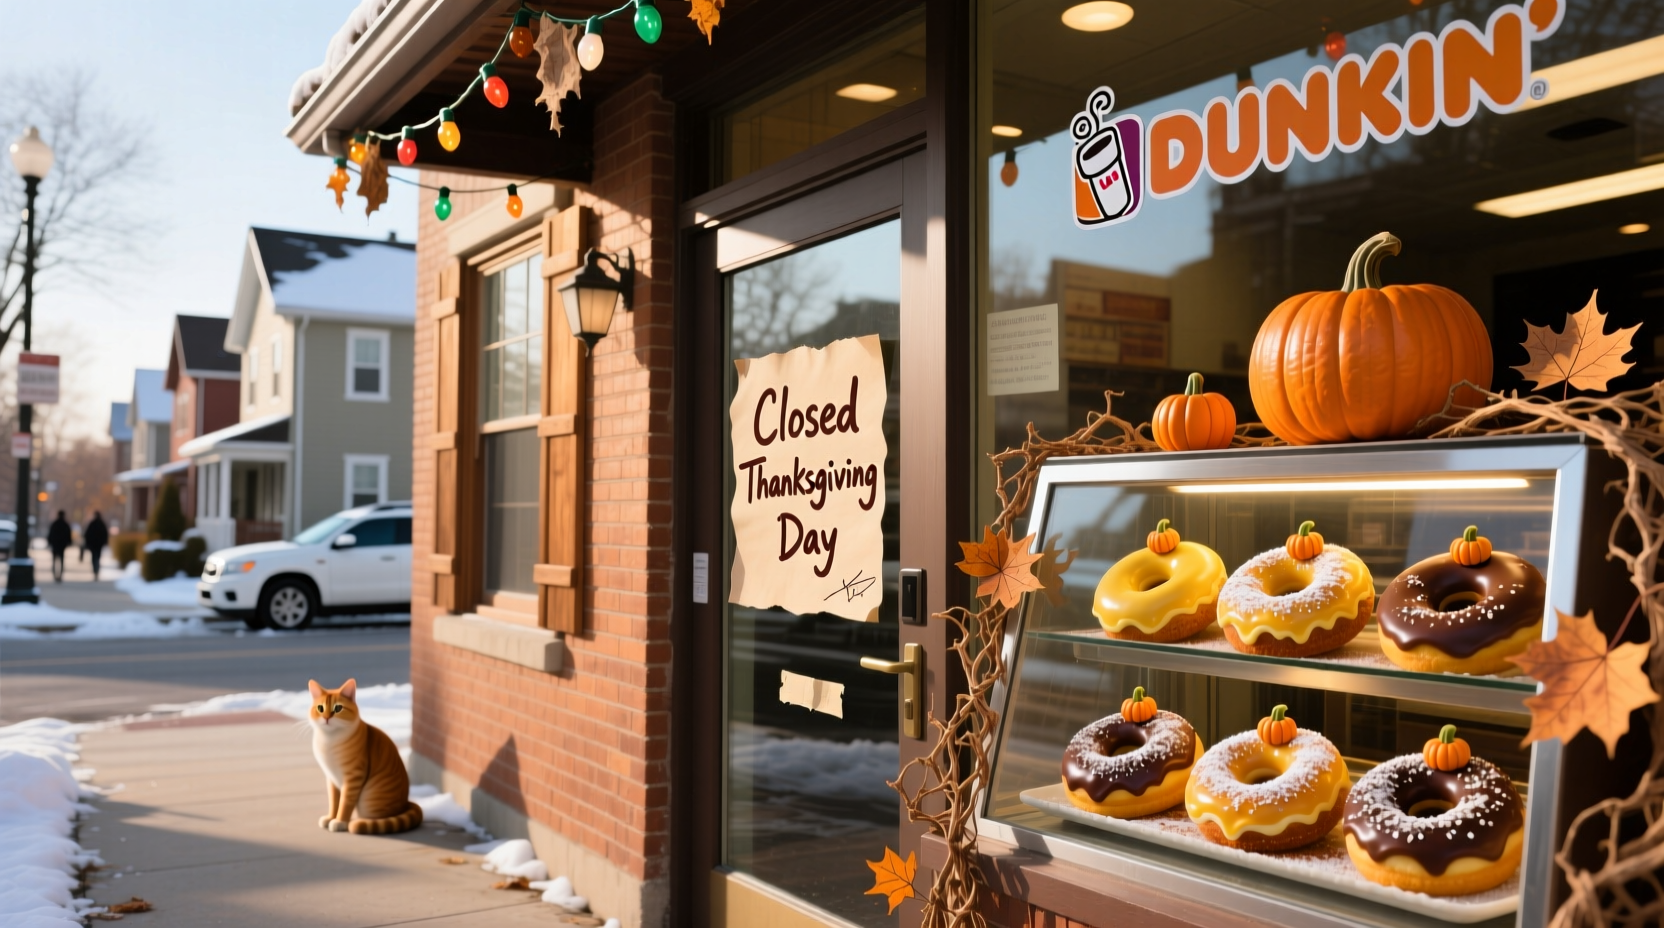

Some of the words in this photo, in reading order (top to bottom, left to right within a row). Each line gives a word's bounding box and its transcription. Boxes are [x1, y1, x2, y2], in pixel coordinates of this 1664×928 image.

[753, 375, 860, 447] Closed
[739, 455, 878, 512] Thanksgiving
[776, 512, 838, 578] Day
